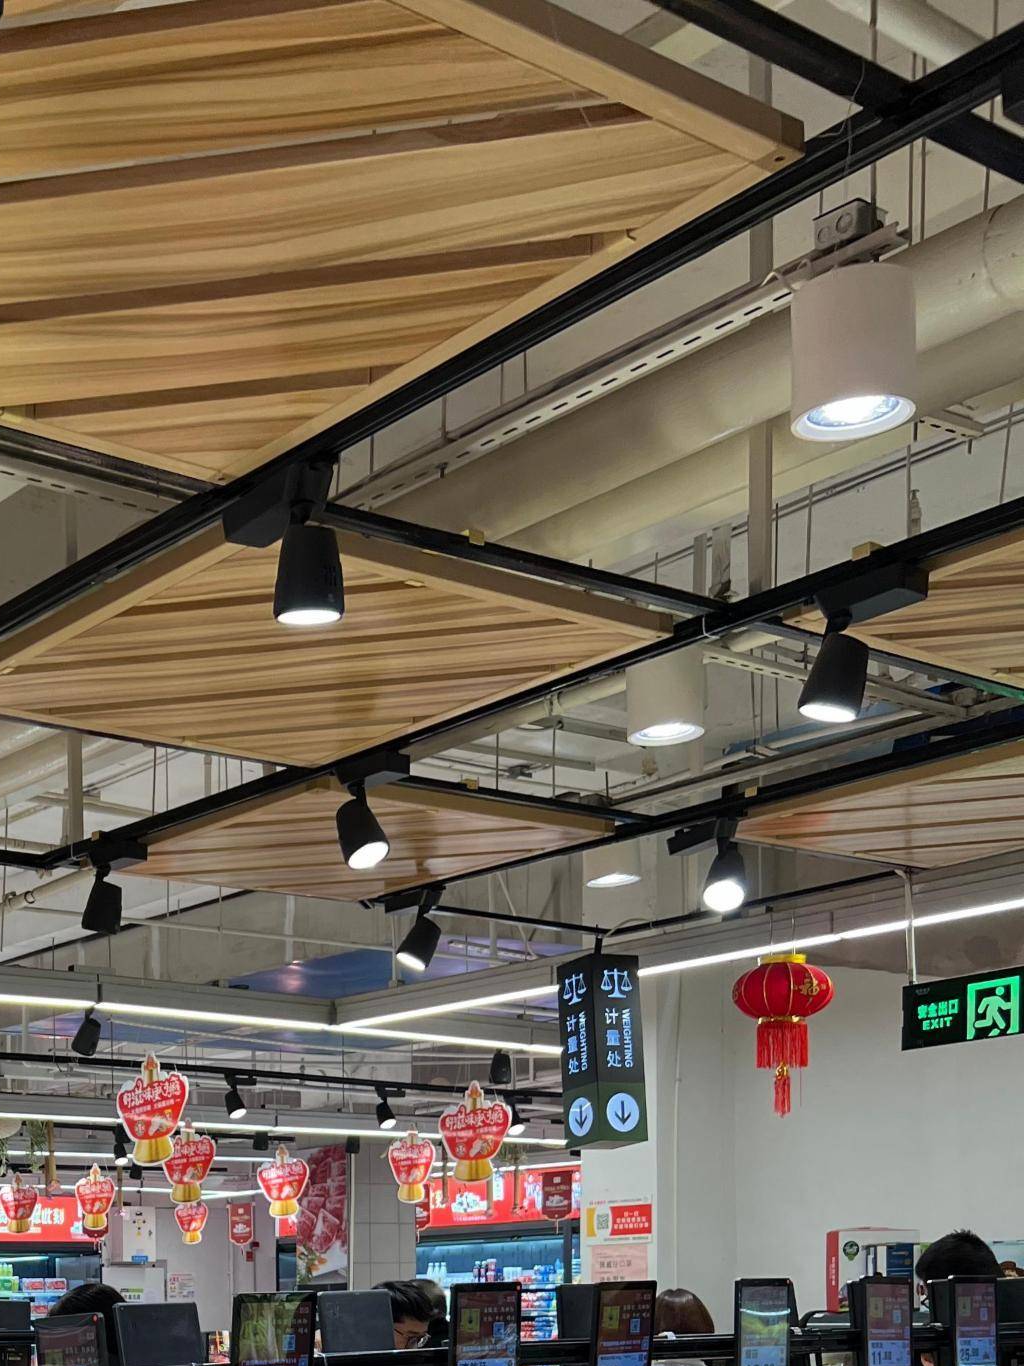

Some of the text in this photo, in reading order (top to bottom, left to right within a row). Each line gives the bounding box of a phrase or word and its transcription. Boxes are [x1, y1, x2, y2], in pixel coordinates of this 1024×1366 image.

[605, 1007, 622, 1067] 计量处
[622, 1008, 634, 1068] WEIGHTING
[918, 999, 959, 1019] 安全出口
[922, 1017, 953, 1031] EXIT
[566, 1015, 579, 1075] 计量处
[579, 1011, 588, 1071] WEIGHTING
